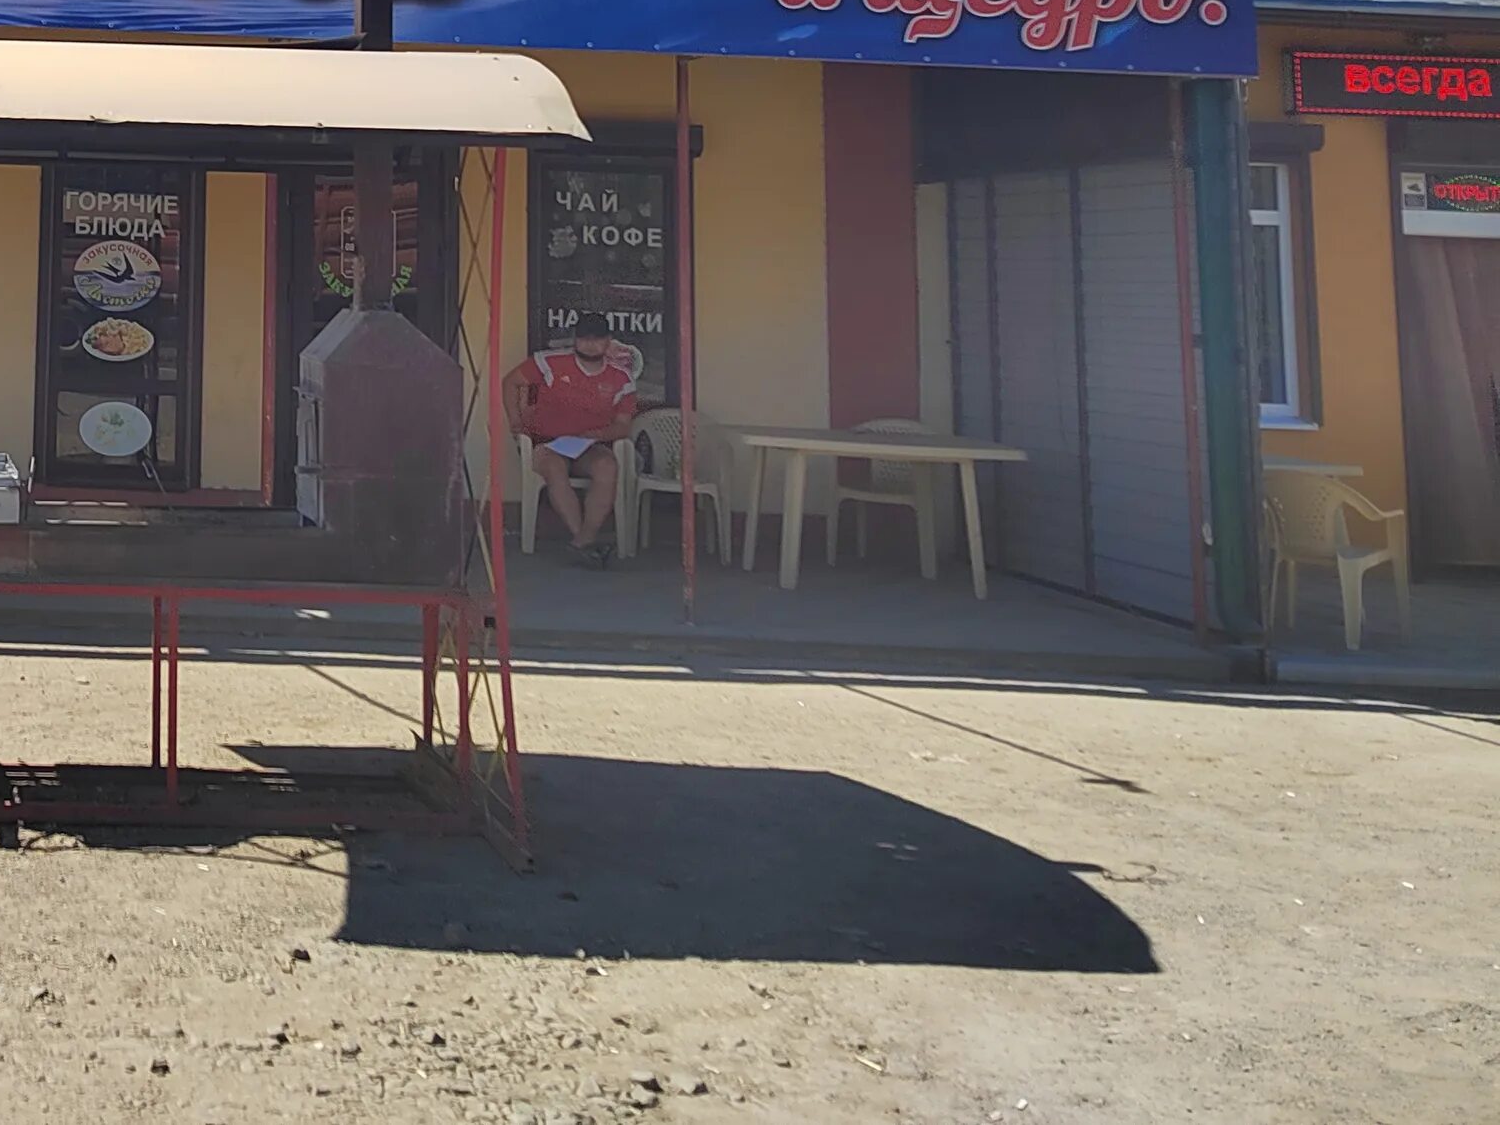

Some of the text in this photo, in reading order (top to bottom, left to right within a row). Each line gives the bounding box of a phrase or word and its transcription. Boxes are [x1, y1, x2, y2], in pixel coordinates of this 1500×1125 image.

[1343, 63, 1493, 102] всегда
[65, 190, 180, 215] ГОРЯЧИЕ
[555, 188, 619, 213] ЧАЙ
[74, 215, 167, 242] БЛЮДА
[582, 225, 664, 248] КОФЕ
